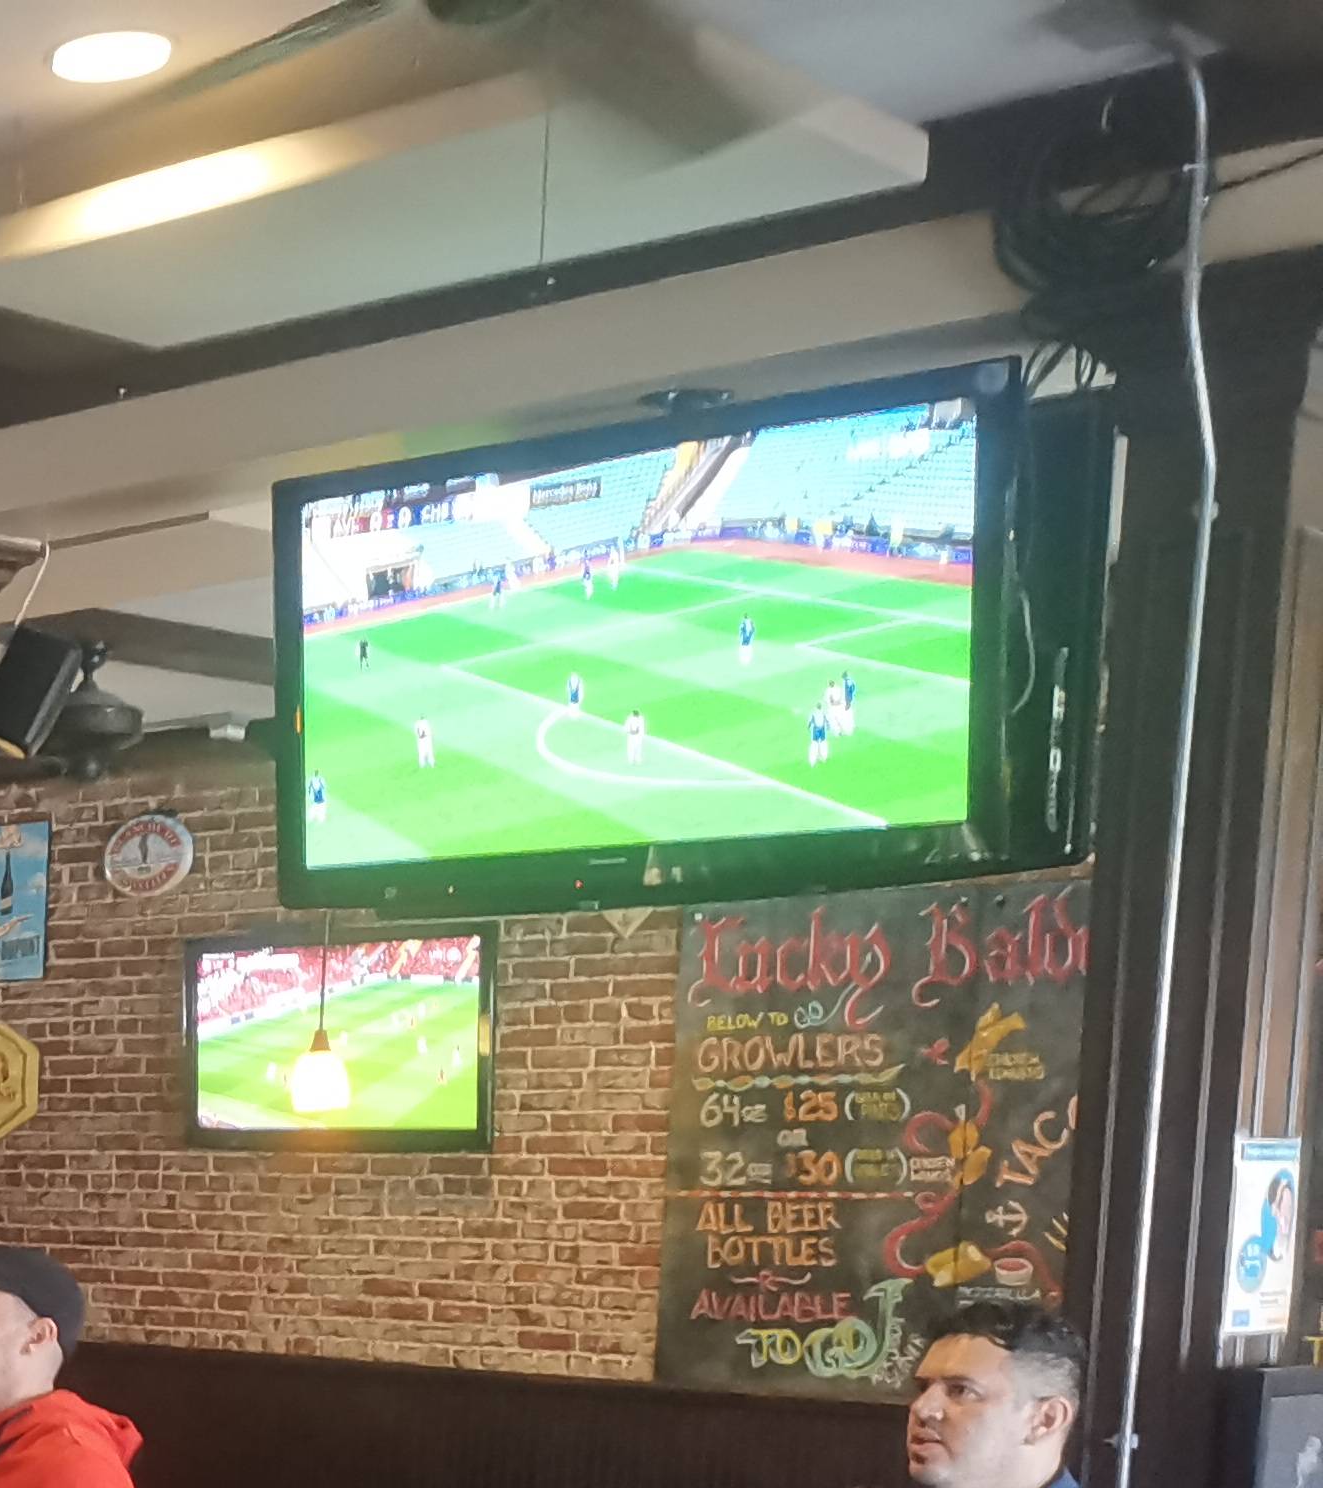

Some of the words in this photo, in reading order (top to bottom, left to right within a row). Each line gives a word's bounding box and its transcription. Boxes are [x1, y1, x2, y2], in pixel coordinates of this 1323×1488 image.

[687, 906, 893, 1030] Lucky
[706, 1011, 766, 1031] BELOW
[768, 1011, 789, 1026] TO
[698, 1033, 886, 1073] GROWLERS
[784, 1089, 839, 1123] $25
[696, 1201, 754, 1235] ALL
[767, 1200, 842, 1234] BEER
[707, 1235, 838, 1269] BOTTLES
[690, 1287, 859, 1324] AVAILABLE
[735, 1328, 803, 1368] TO
[805, 1316, 879, 1379] GO
